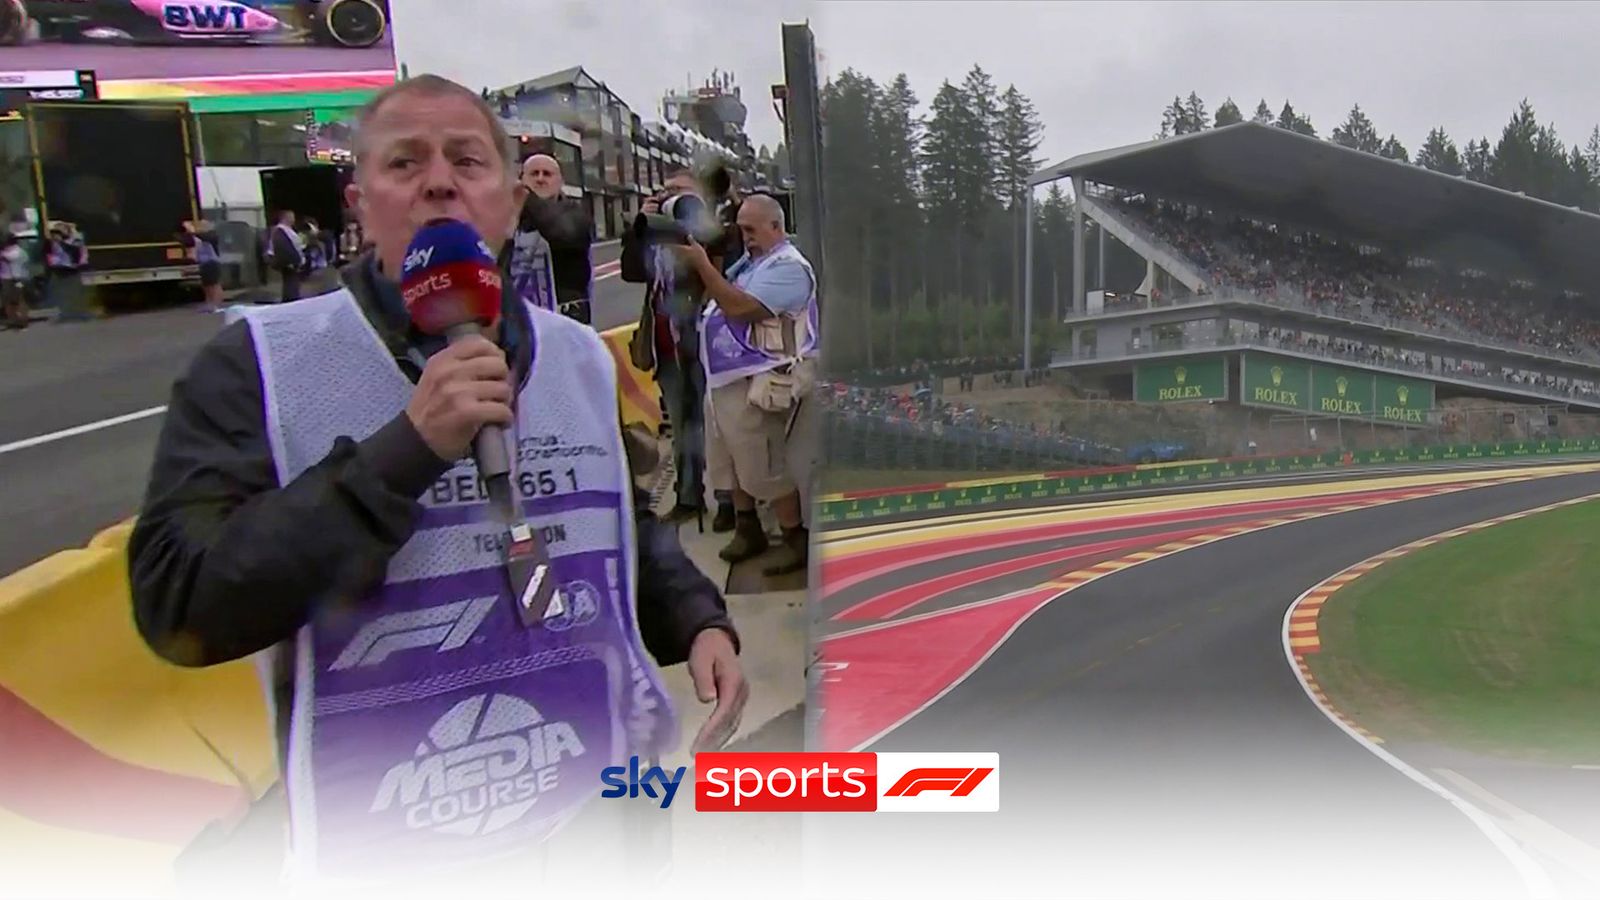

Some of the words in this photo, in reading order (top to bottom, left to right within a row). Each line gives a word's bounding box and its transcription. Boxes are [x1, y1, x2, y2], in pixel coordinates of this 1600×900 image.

[164, 5, 248, 29] BWT
[403, 246, 434, 272] sky
[1159, 386, 1202, 400] ROLEX
[1255, 387, 1298, 405] ROLEX
[1321, 398, 1362, 414] ROLEX
[1384, 406, 1422, 422] ROLEX
[368, 721, 587, 813] MEDIA
[405, 767, 560, 830] COURSE
